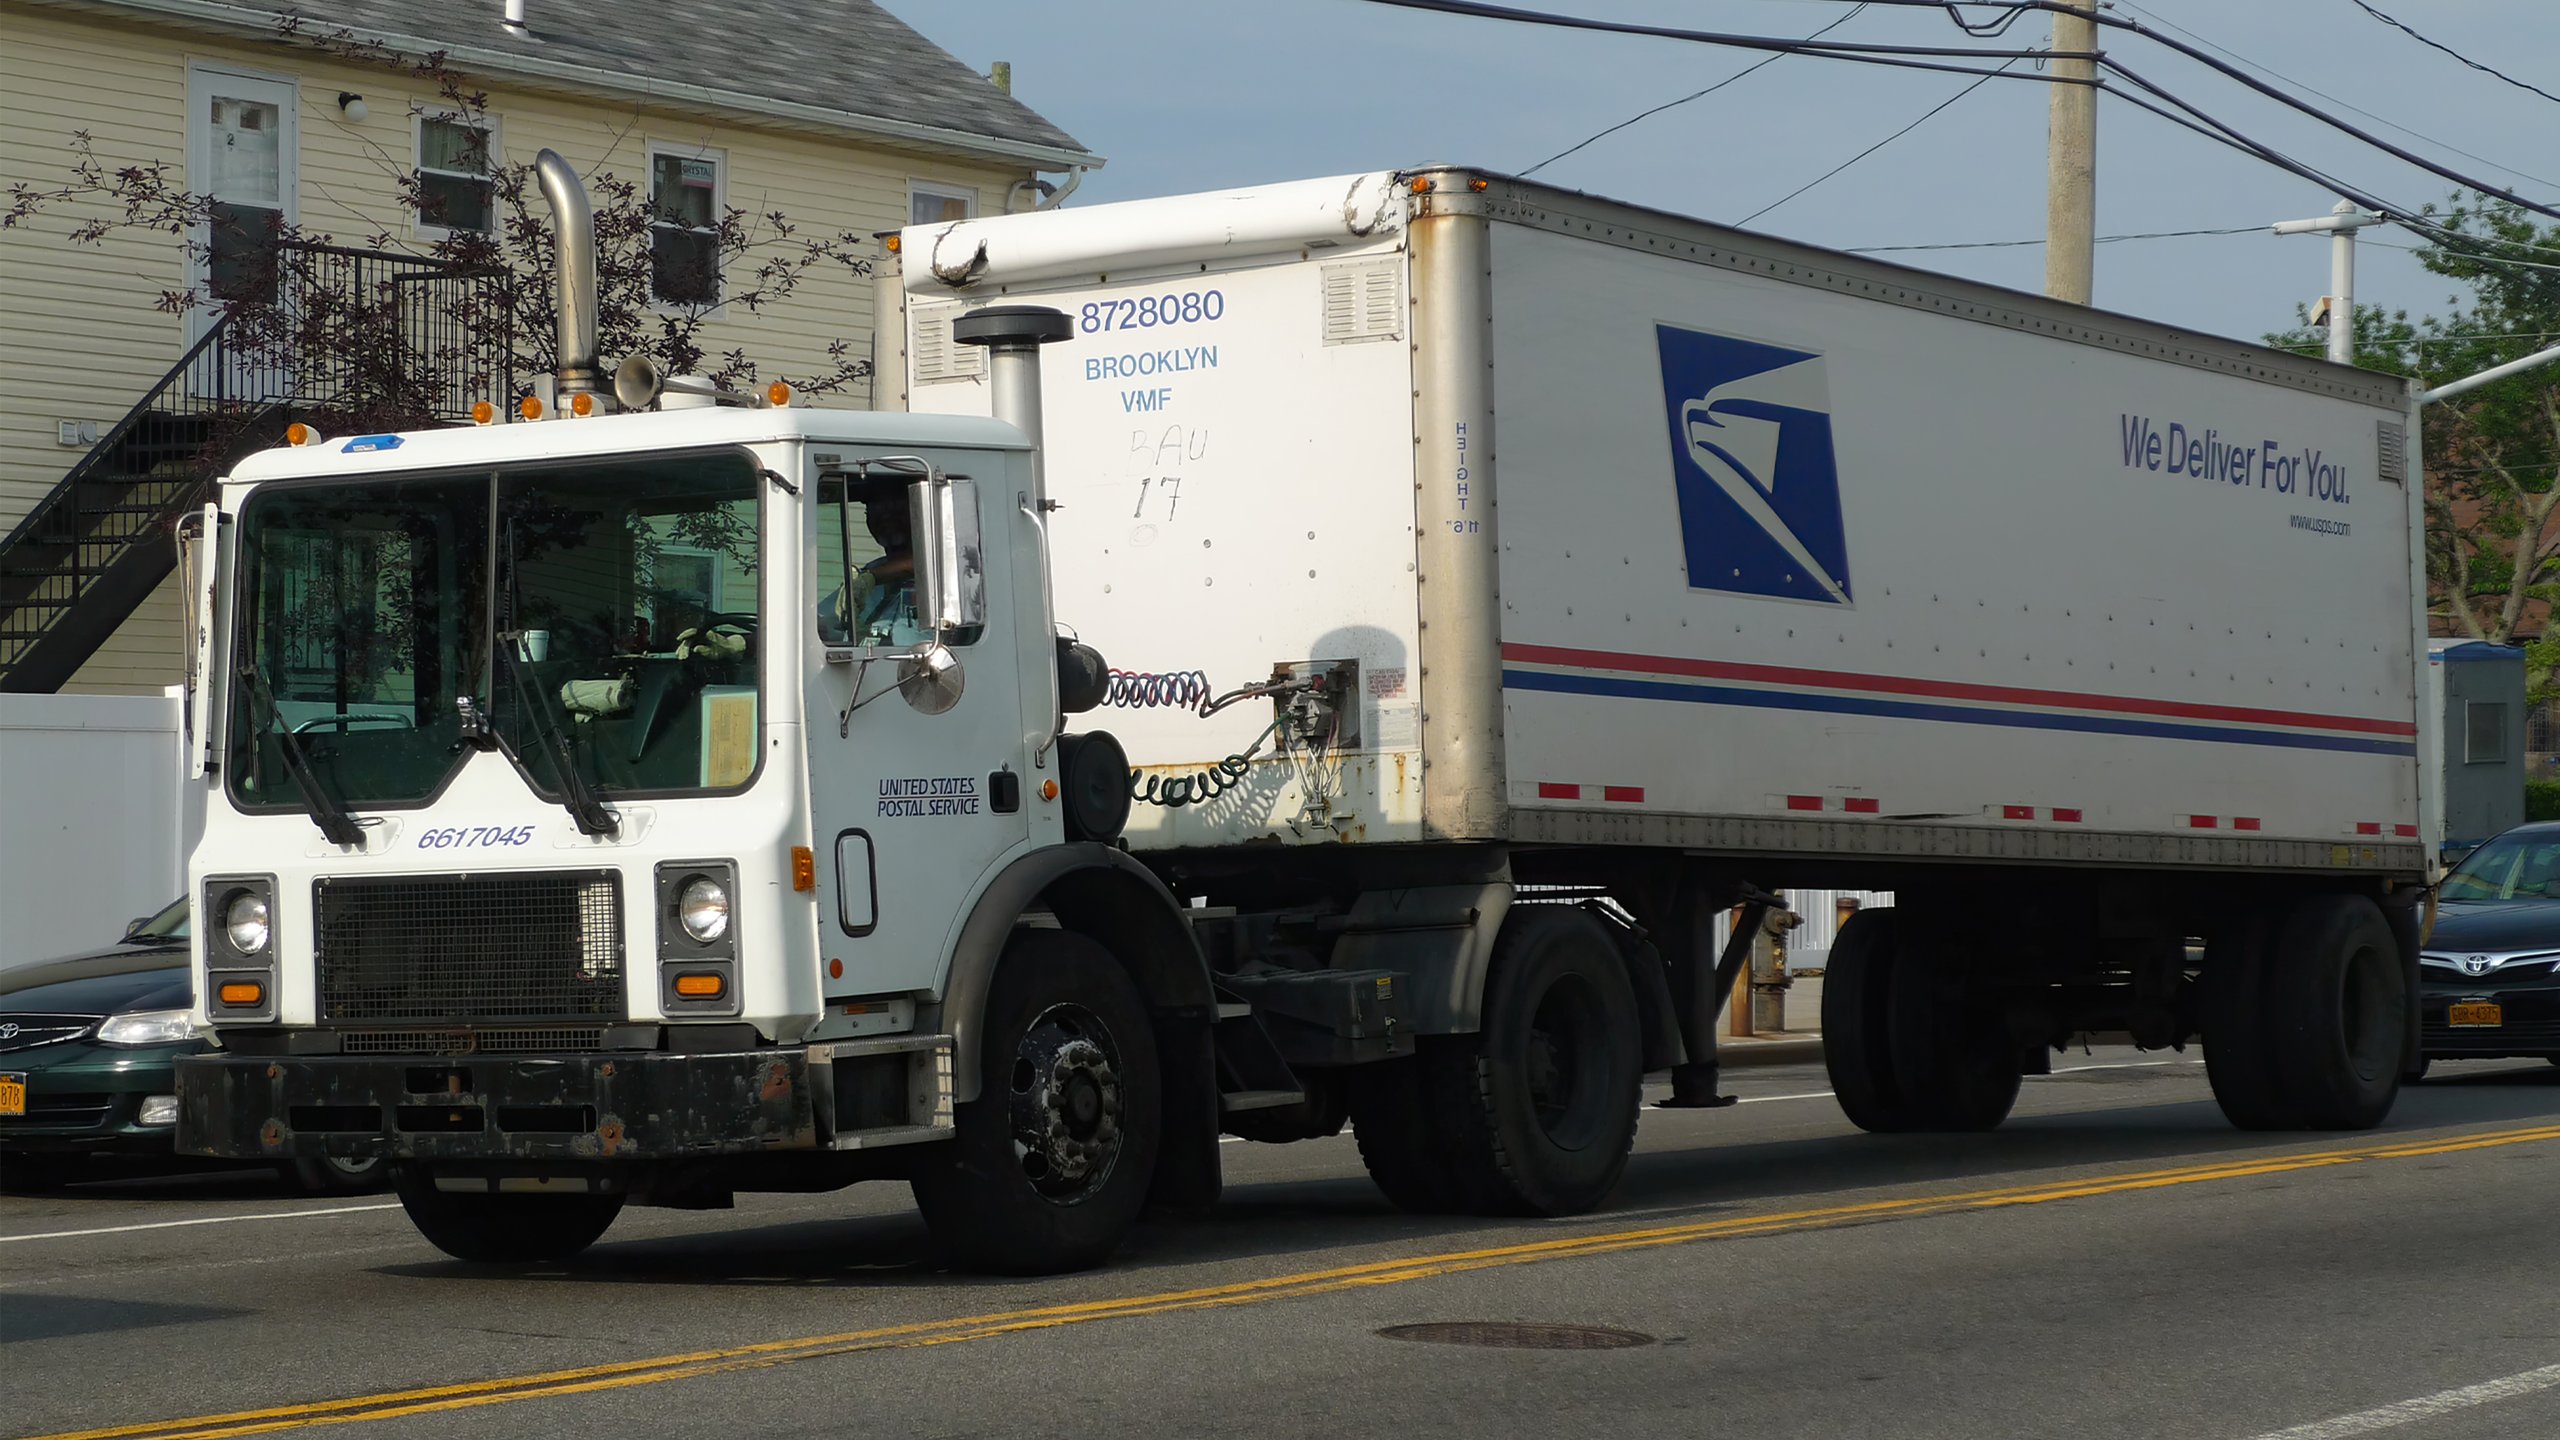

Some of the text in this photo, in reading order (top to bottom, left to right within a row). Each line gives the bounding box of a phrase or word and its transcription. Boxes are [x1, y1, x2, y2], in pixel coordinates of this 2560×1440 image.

[227, 132, 235, 146] 2
[1081, 290, 1225, 334] 8728080
[1086, 345, 1218, 381] BROOKLYN
[1121, 388, 1172, 413] VMF
[2122, 413, 2350, 504] We Deliver For You.
[1134, 477, 1181, 522] 17
[2290, 514, 2351, 537] www.usps.com
[879, 777, 975, 796] UNITED STATES
[877, 798, 979, 817] POSTAL SERVICE
[418, 825, 536, 849] 6617045
